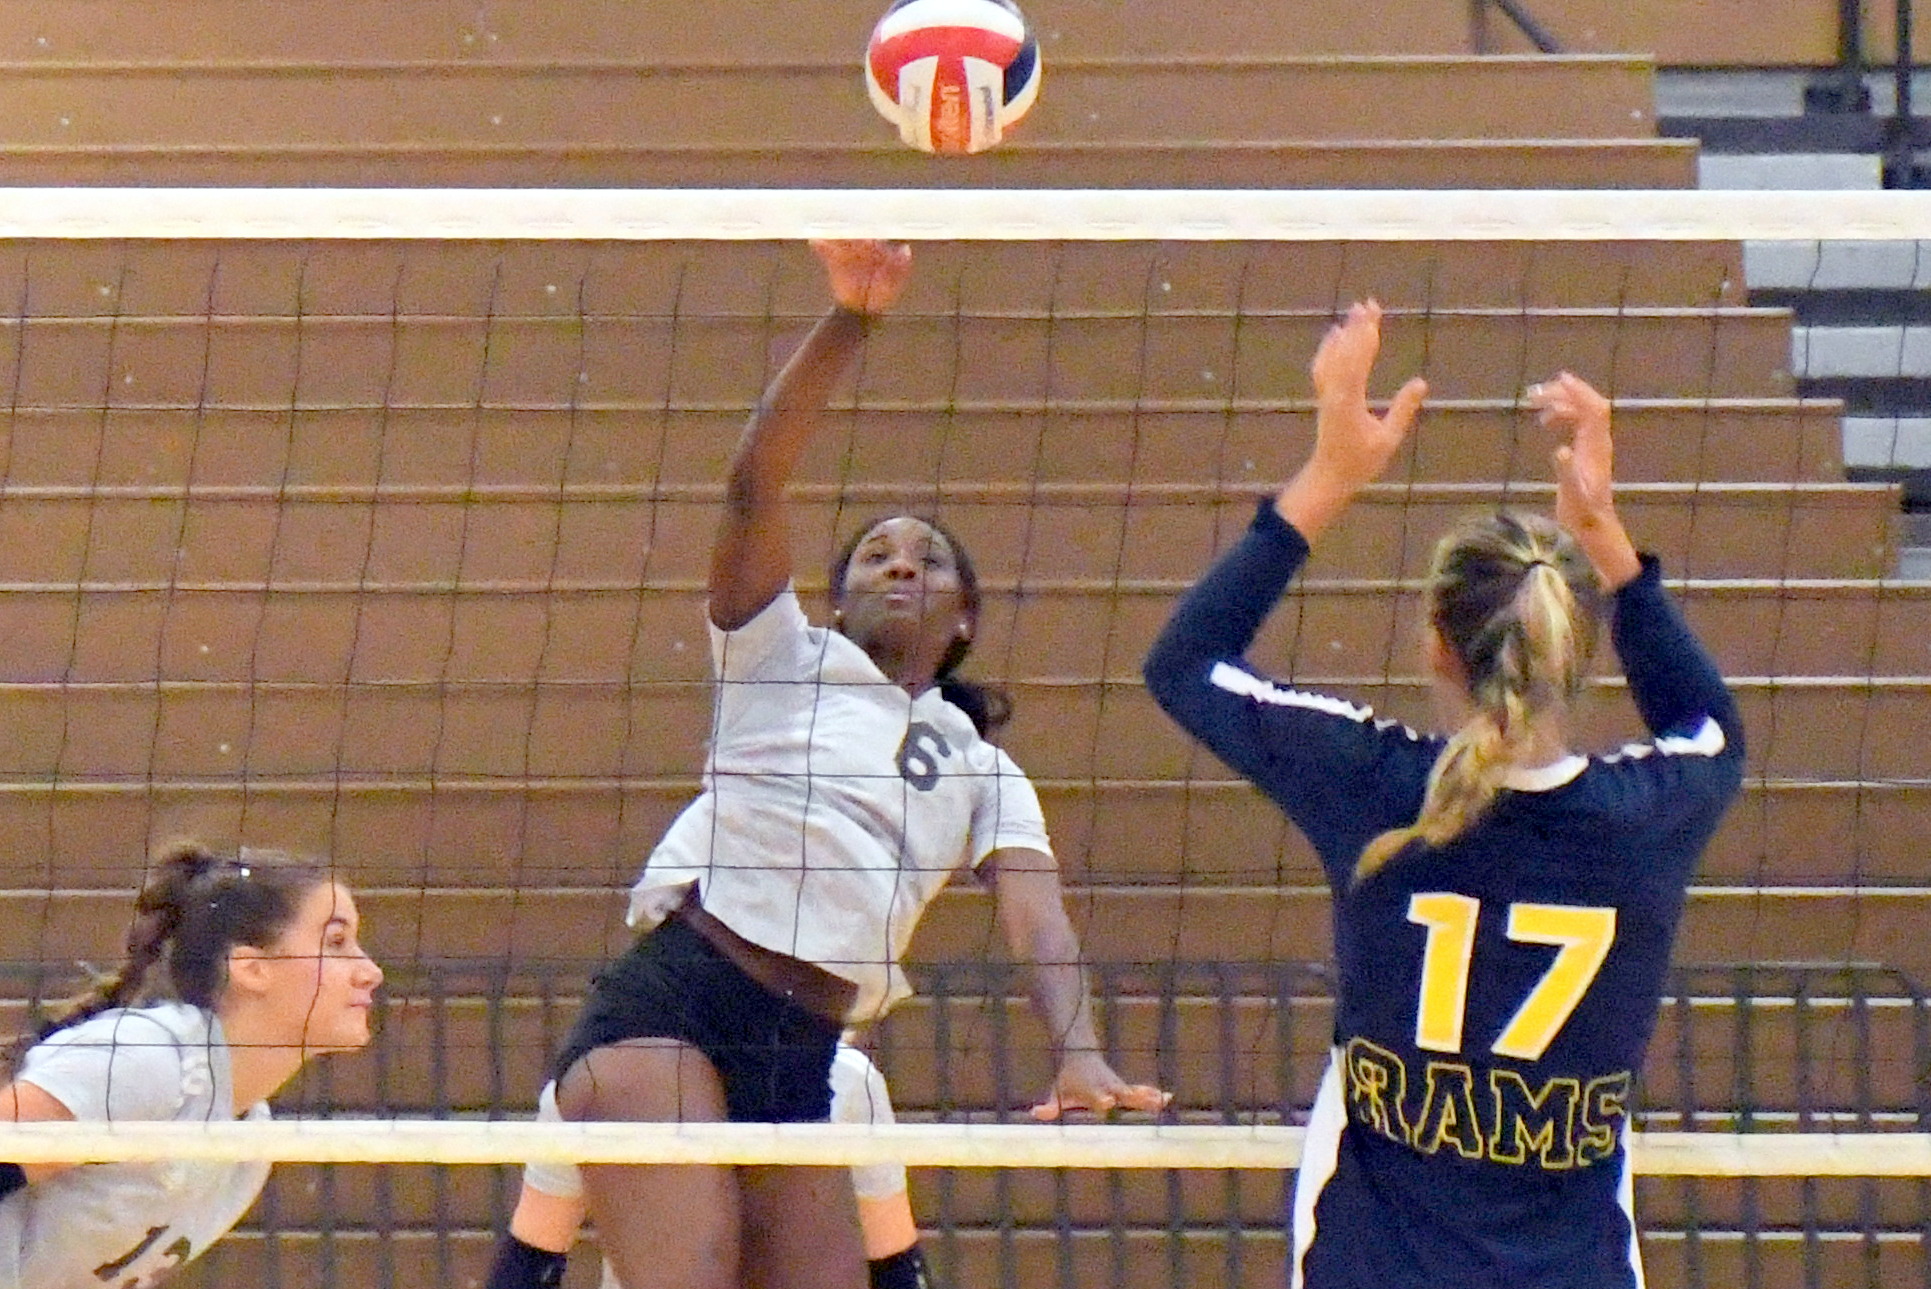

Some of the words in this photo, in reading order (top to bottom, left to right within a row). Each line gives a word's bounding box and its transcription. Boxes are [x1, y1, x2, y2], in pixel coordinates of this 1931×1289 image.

[895, 721, 951, 791] 6
[1407, 892, 1617, 1061] 17
[1346, 1037, 1631, 1170] RAMS
